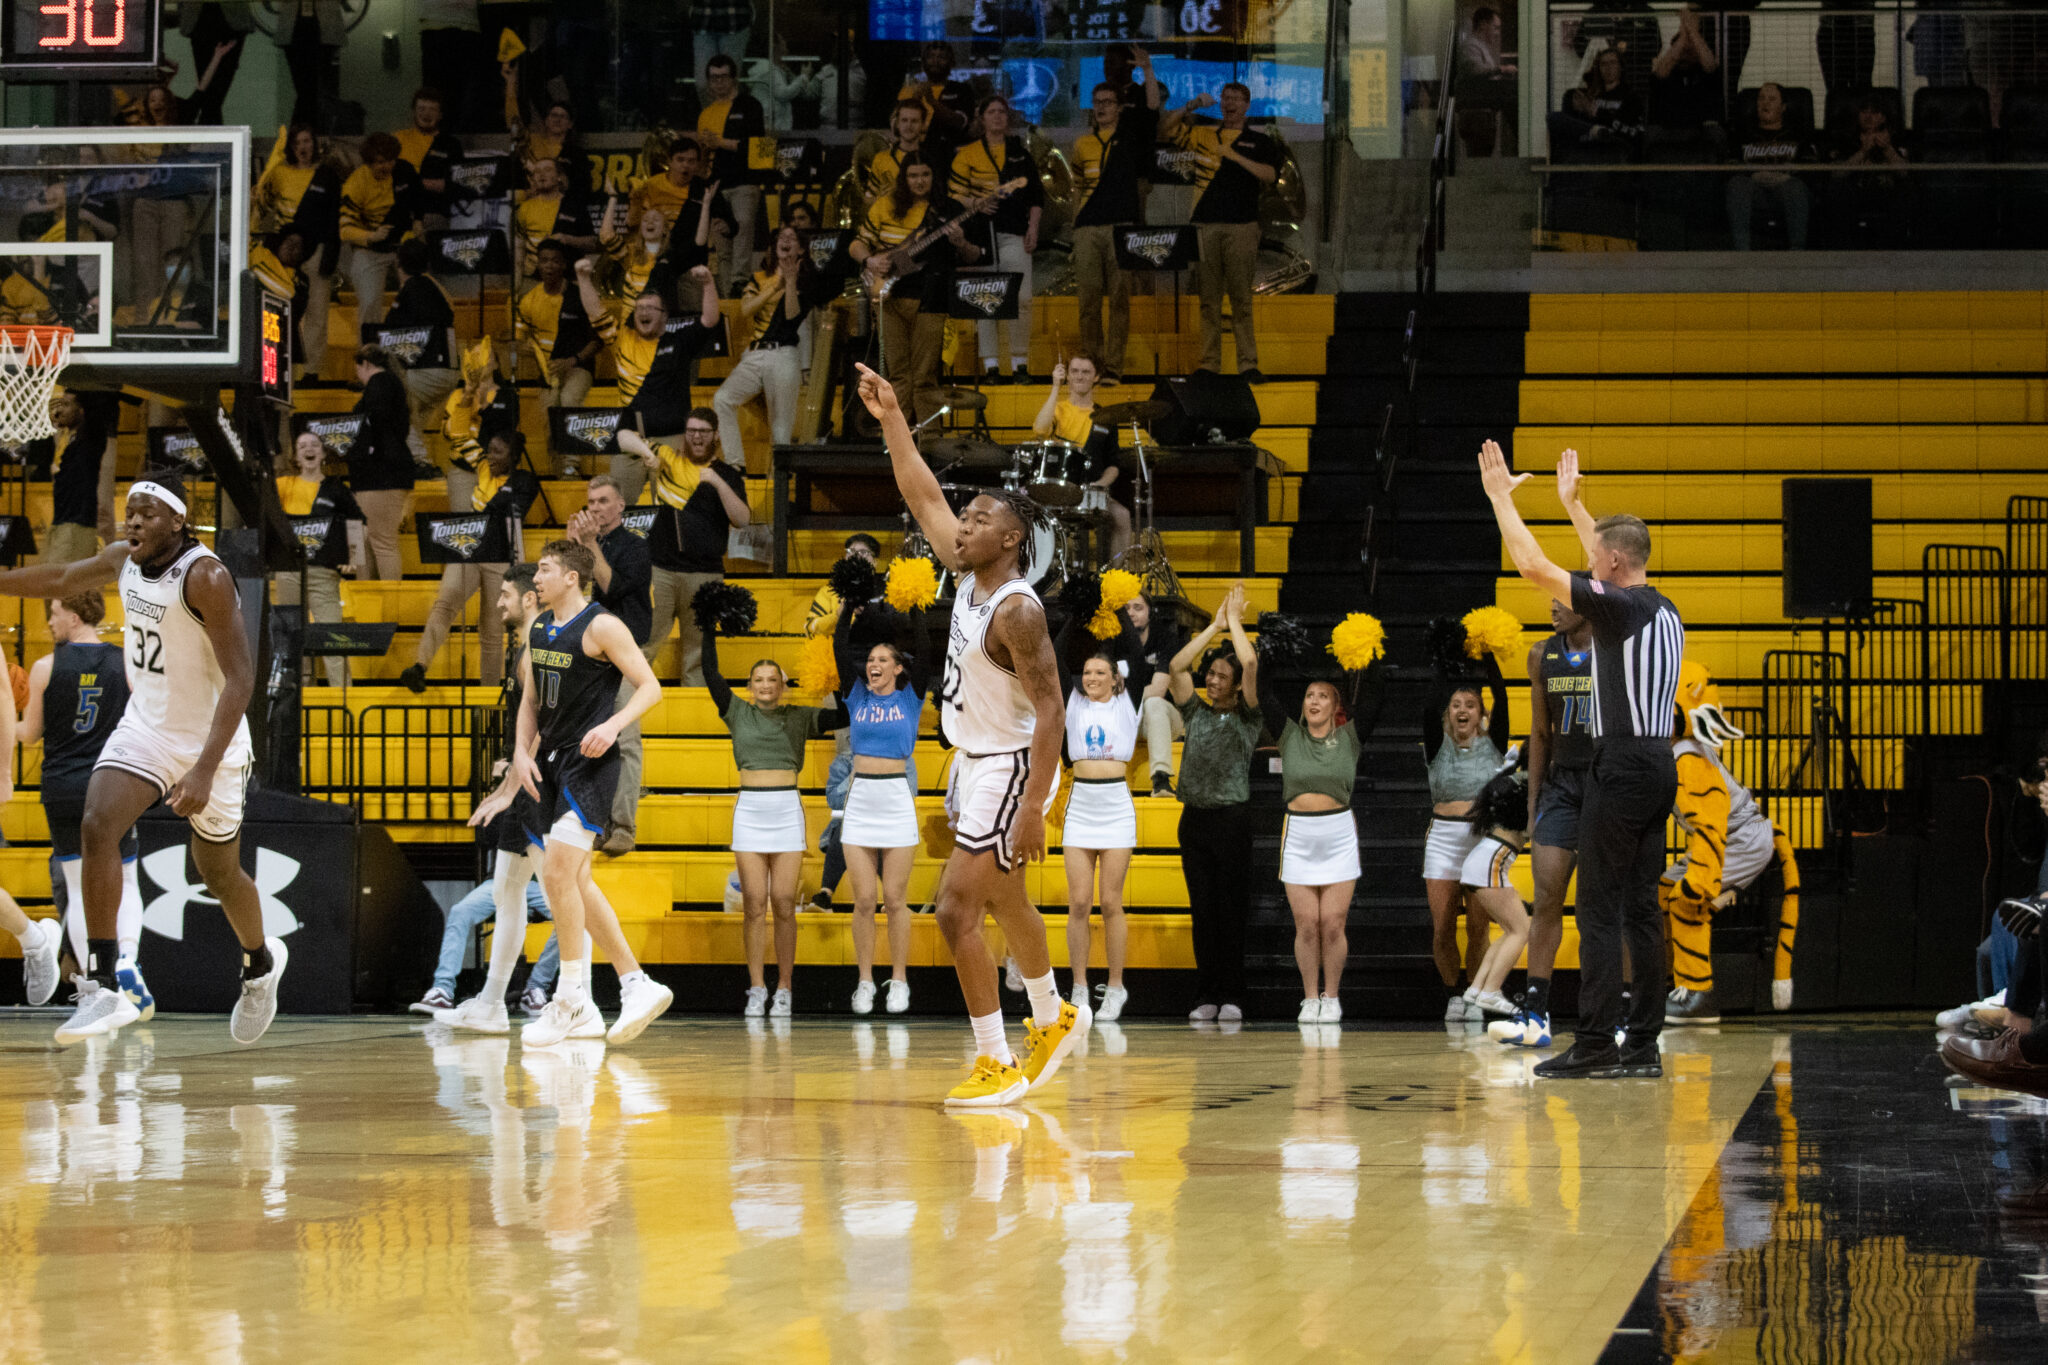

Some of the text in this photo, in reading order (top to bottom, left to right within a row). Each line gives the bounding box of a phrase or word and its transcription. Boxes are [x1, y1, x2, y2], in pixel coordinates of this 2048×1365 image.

[38, 0, 126, 47] 30
[1156, 149, 1195, 167] TOWSO
[164, 436, 200, 453] TOWS
[429, 520, 488, 543] TOWSON
[127, 589, 166, 624] TOWSON
[131, 624, 165, 675] 32
[545, 649, 573, 669] HENS
[539, 668, 561, 709] 10
[1547, 676, 1575, 692] BLUE
[72, 687, 104, 733] 5
[1560, 695, 1592, 734] 14
